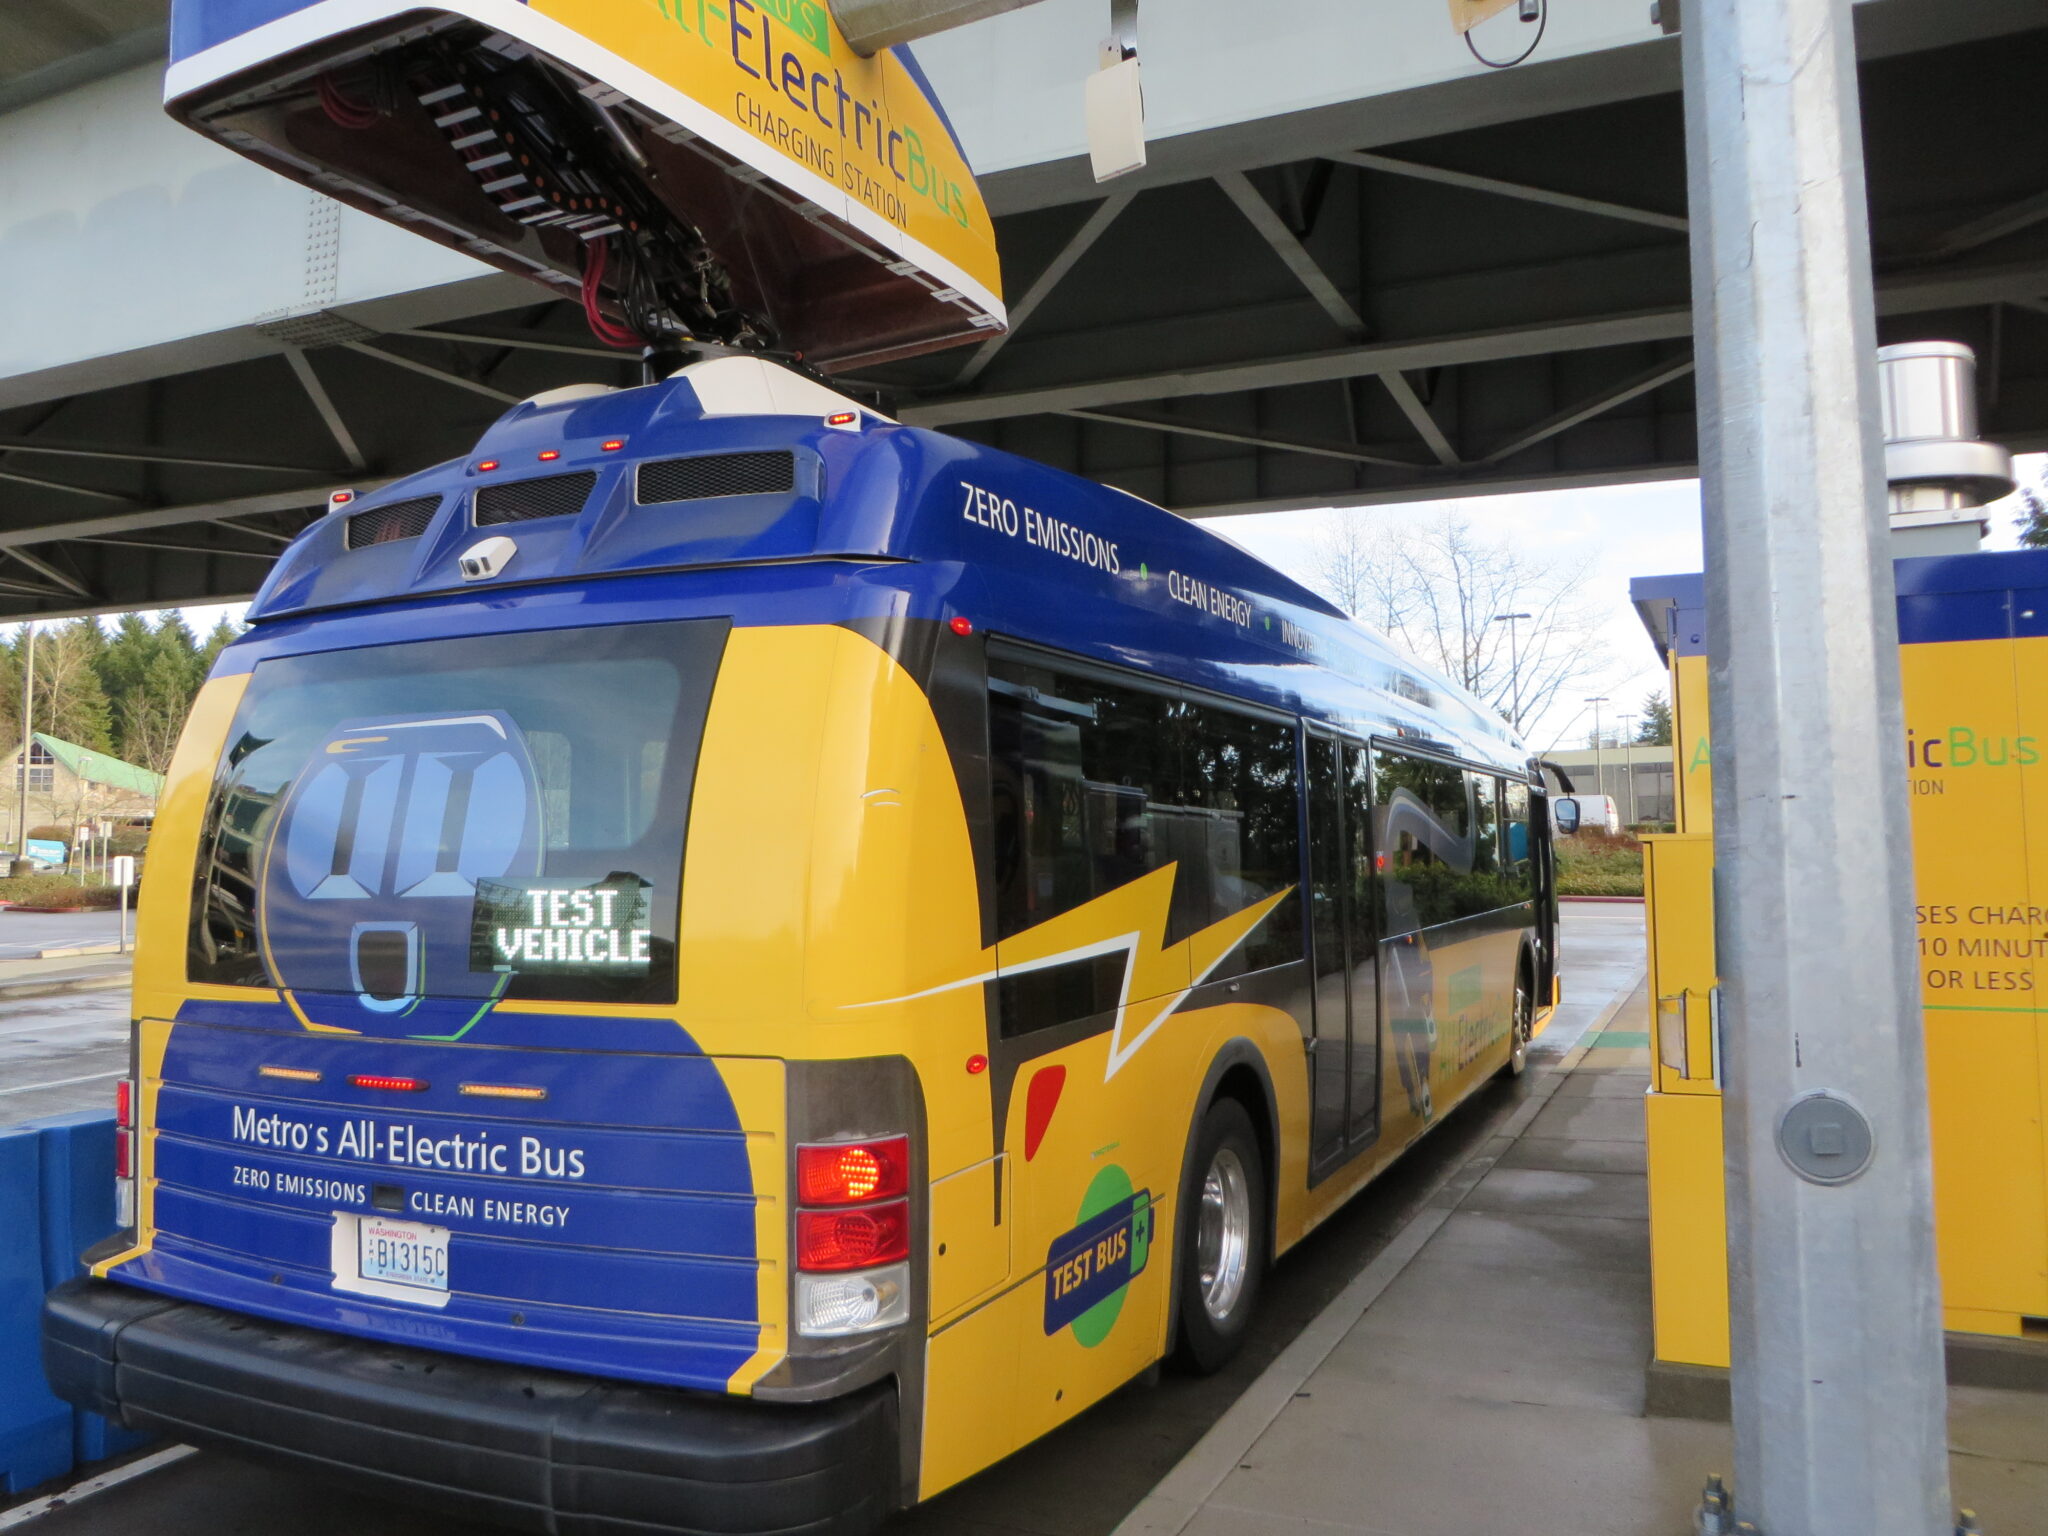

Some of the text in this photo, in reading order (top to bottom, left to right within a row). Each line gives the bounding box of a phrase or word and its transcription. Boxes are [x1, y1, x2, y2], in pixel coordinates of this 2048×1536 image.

[736, 92, 907, 229] CHARGING STATION
[961, 481, 1018, 537] ZERO
[1024, 507, 1120, 575] EMISSIONS
[1168, 570, 1208, 611] CLEAN
[1210, 587, 1252, 630] ENERGY
[1906, 779, 1944, 795] ION
[527, 889, 618, 926] TEST
[1968, 906, 2048, 925] CHAR
[497, 928, 651, 962] VEHICLE
[1918, 937, 1948, 957] 10
[1927, 969, 2033, 991] OR LESS
[233, 1105, 586, 1178] Metro's All-Electric Bus
[233, 1165, 570, 1228] ZERO EMISSIONS CLEAN ENERGY
[369, 1227, 417, 1240] WASHINGTON
[377, 1239, 445, 1277] B1315C
[1053, 1227, 1128, 1300] TEST BUS
